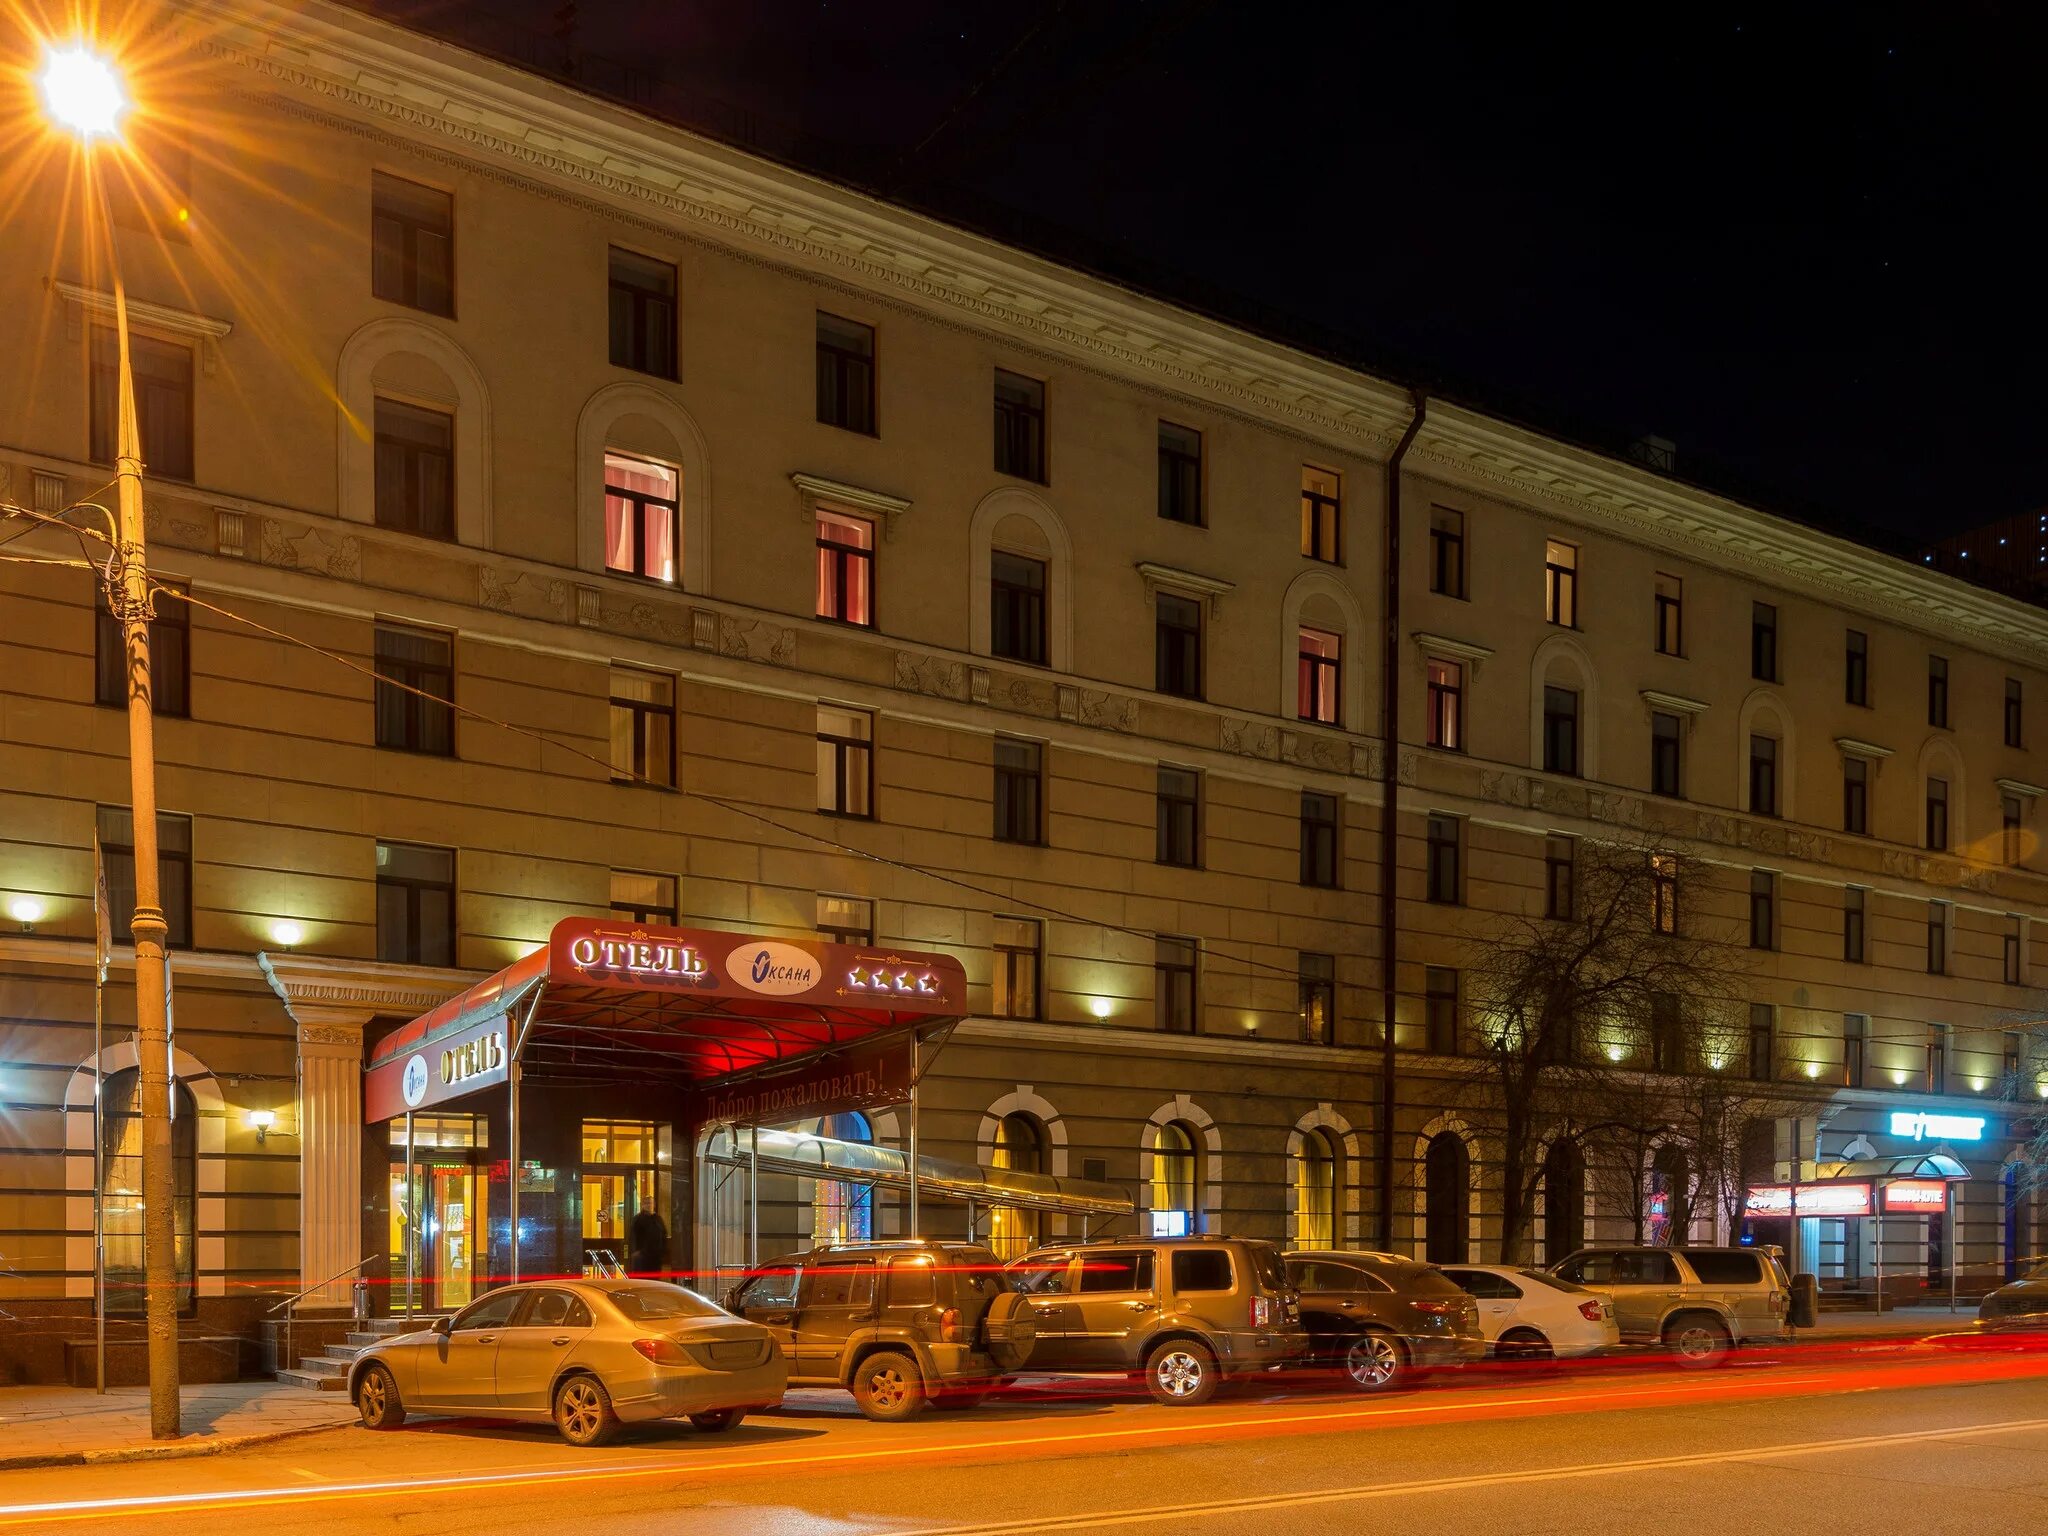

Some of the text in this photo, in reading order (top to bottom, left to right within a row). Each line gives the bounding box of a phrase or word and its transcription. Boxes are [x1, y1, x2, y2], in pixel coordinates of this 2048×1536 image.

[571, 936, 709, 976] ОТЕЛЬ
[441, 1031, 506, 1085] ОТЕЛЬ
[706, 1058, 884, 1122] Добро пожаловать!
